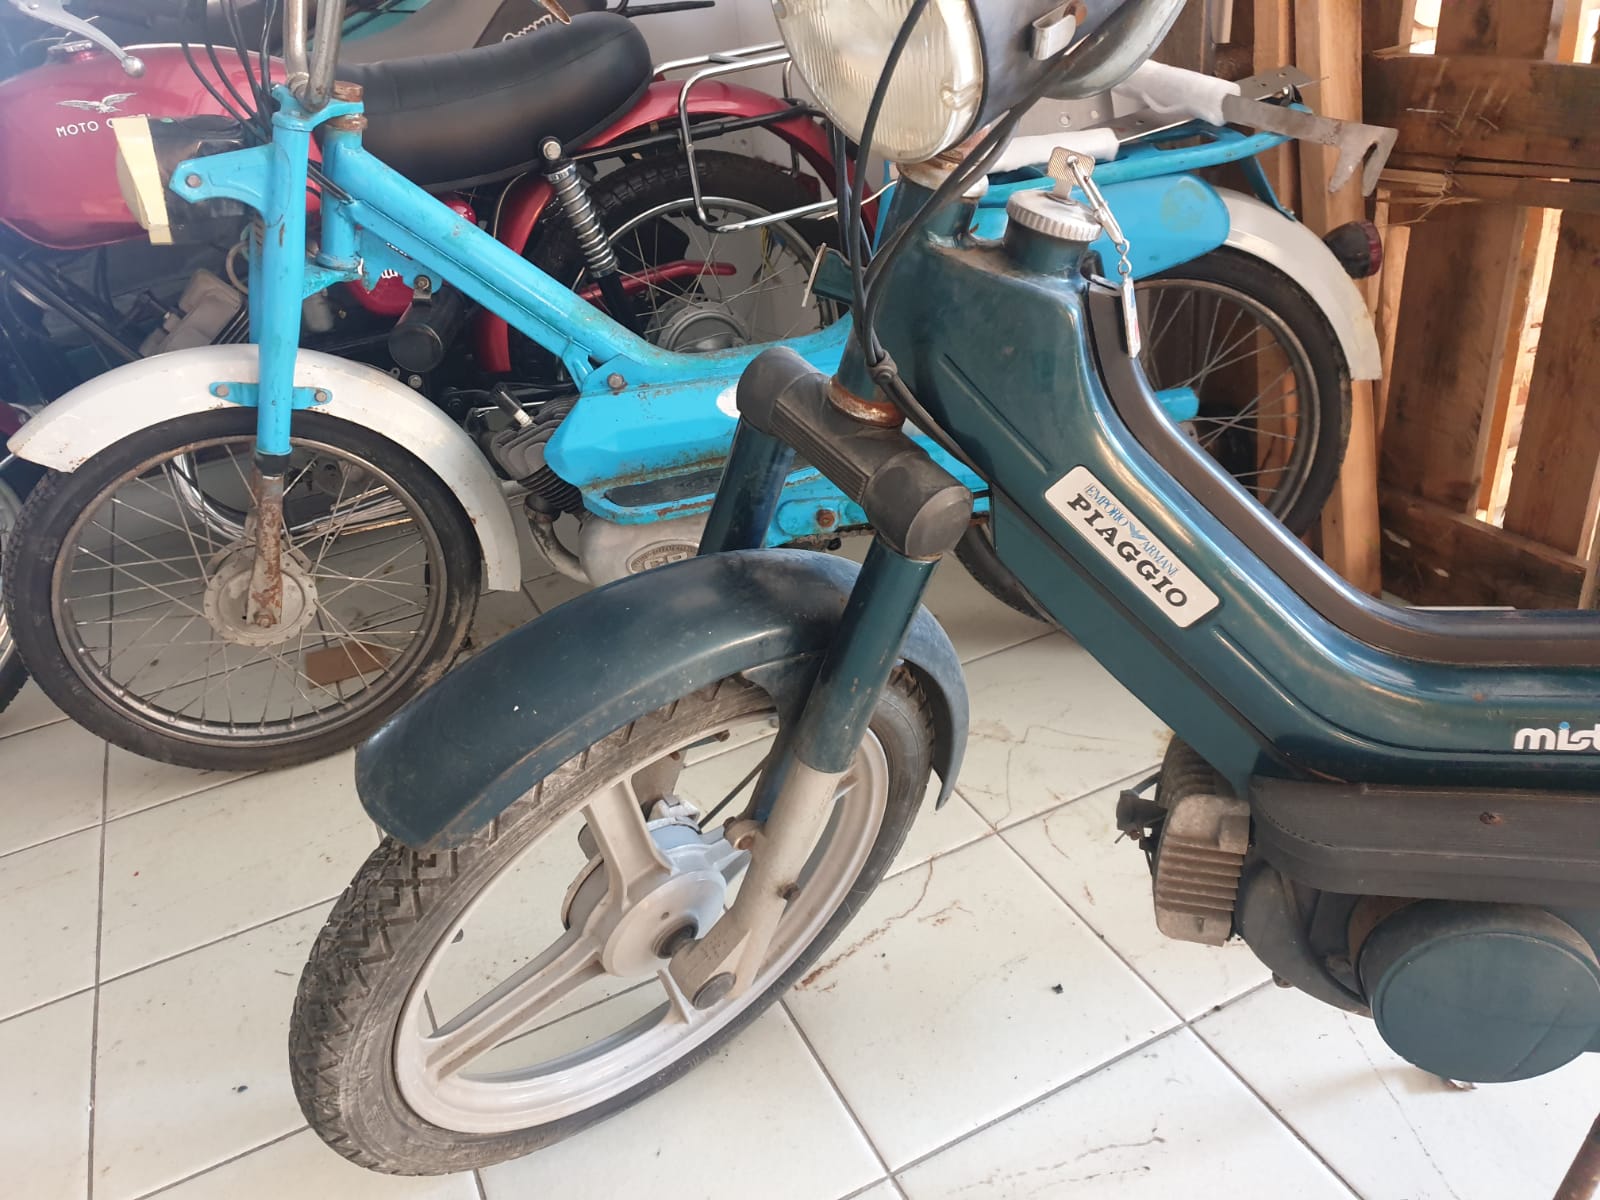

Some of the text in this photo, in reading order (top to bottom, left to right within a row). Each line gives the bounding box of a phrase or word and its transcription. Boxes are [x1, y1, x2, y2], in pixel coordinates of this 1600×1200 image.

[56, 121, 99, 137] MOTO
[1067, 493, 1188, 607] PIAGGIO
[1085, 482, 1179, 577] EMPORIO ARMANI
